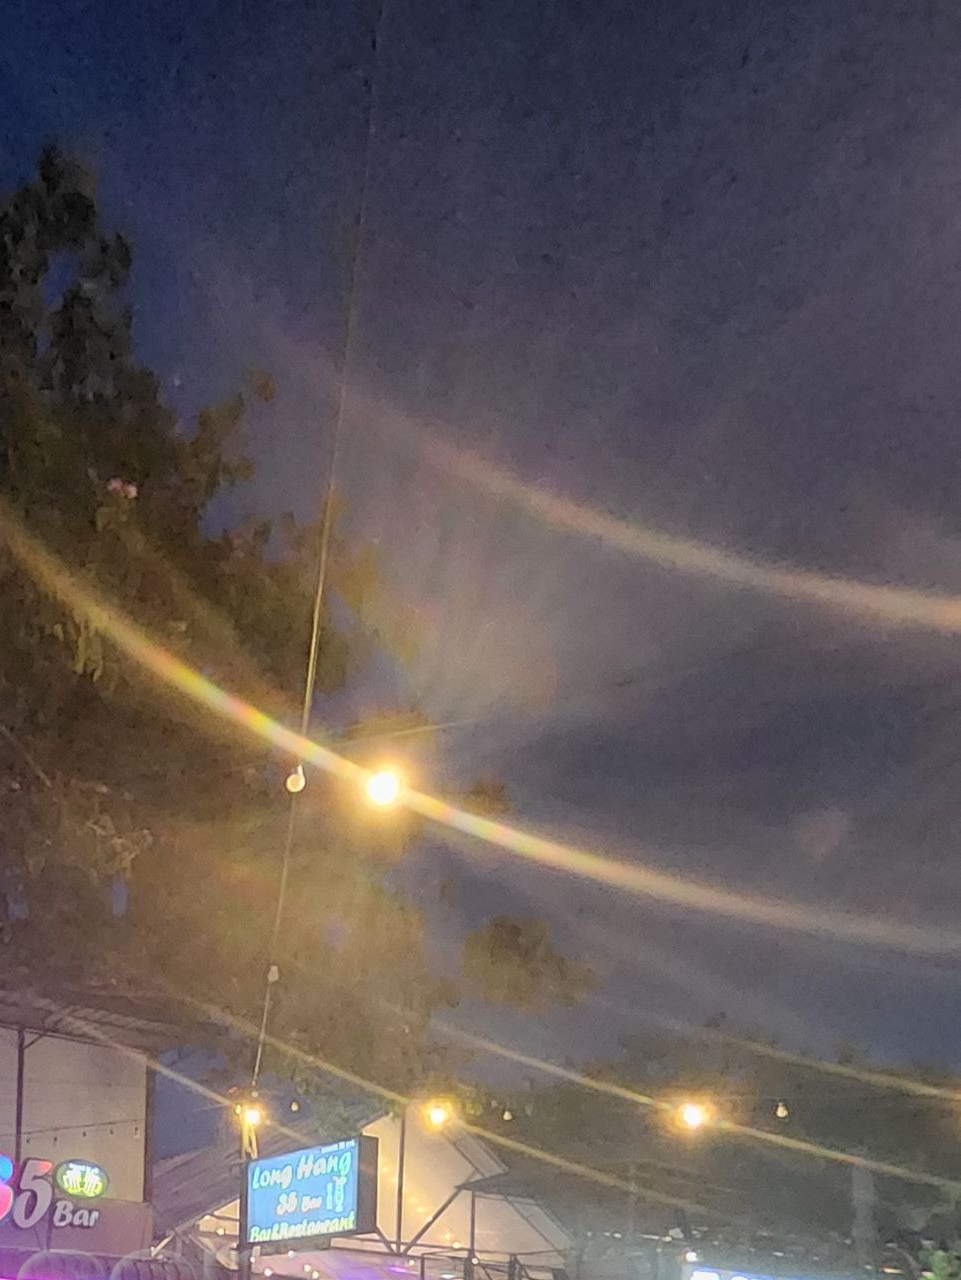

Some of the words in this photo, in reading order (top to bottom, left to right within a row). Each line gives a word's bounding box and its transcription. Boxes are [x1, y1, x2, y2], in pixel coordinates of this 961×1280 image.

[252, 1166, 293, 1190] Long
[297, 1152, 352, 1178] Hang
[52, 1200, 99, 1227] Bar
